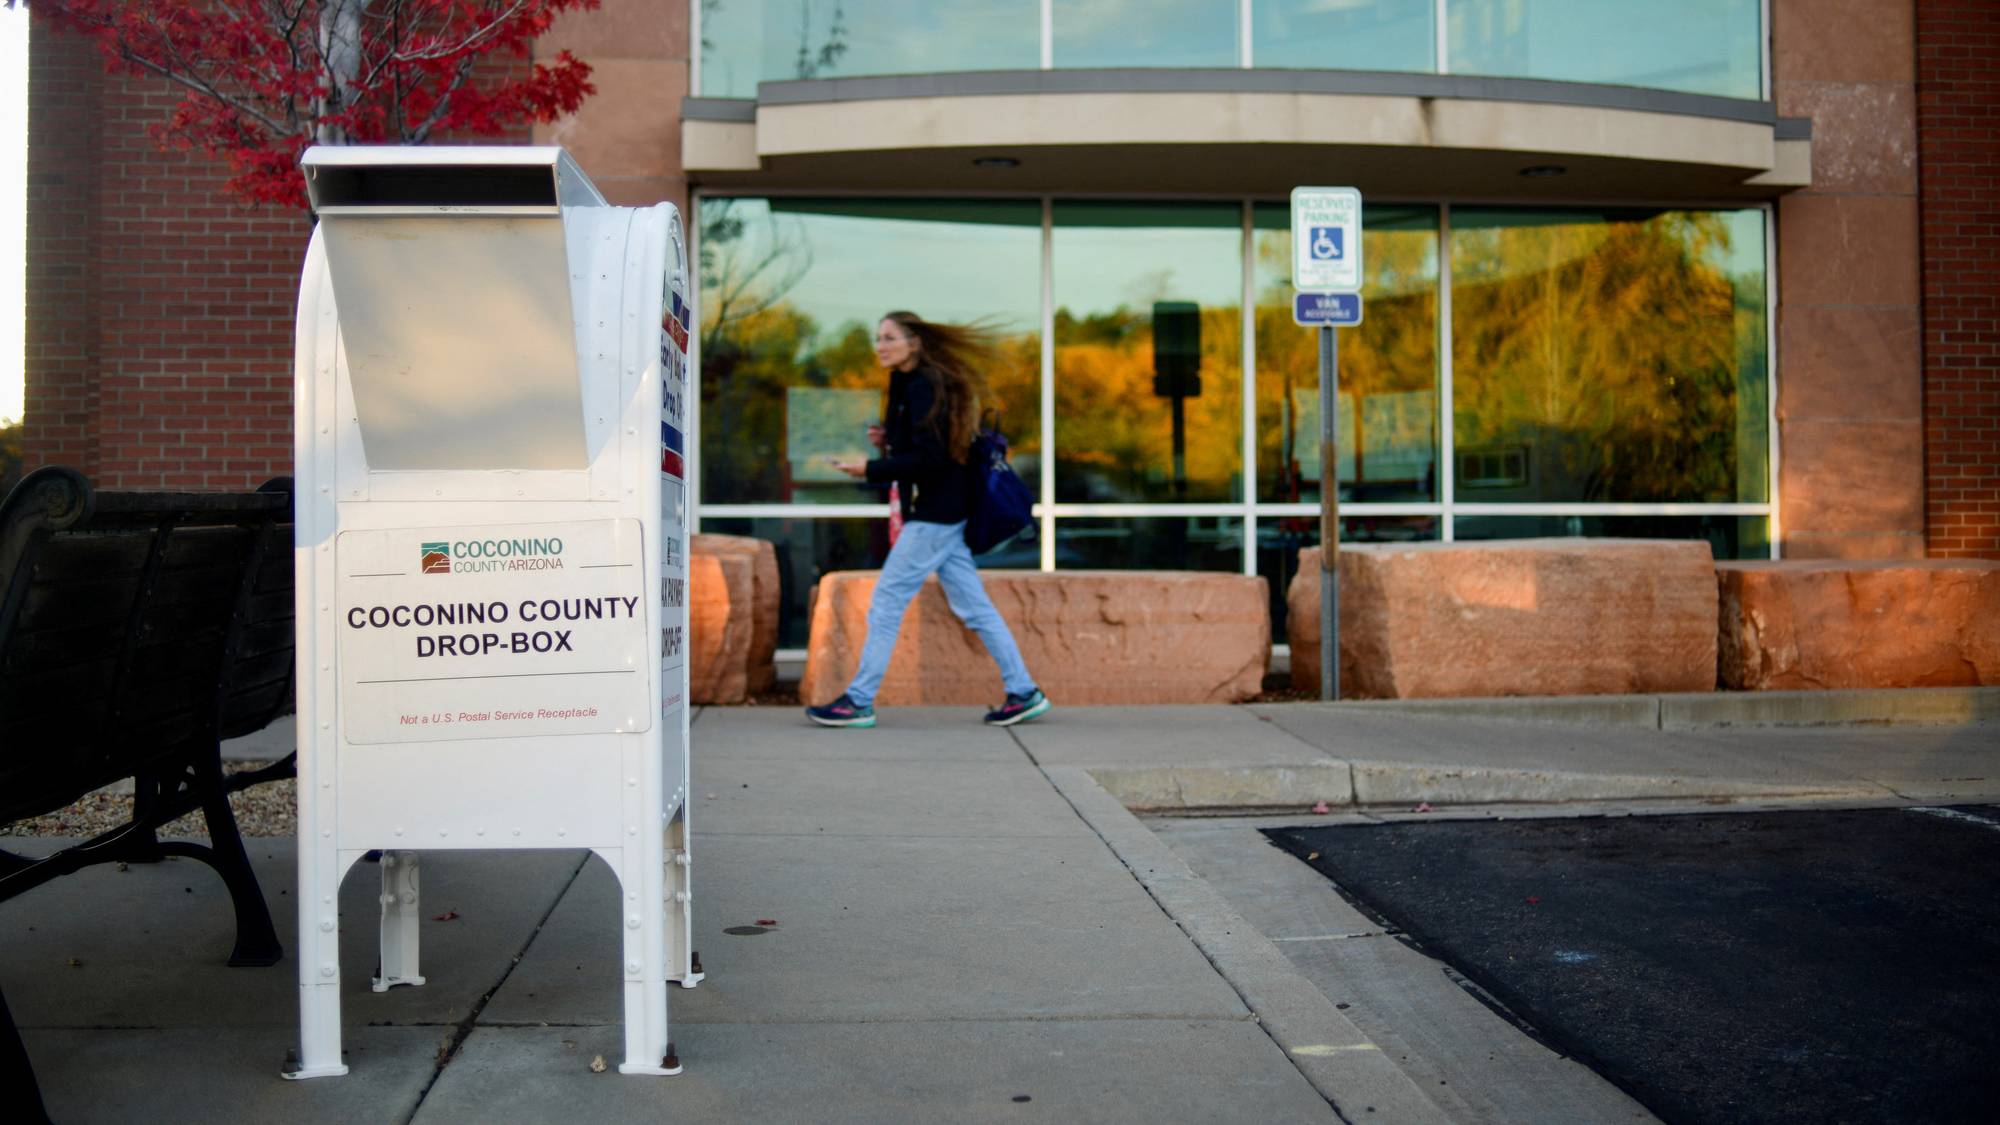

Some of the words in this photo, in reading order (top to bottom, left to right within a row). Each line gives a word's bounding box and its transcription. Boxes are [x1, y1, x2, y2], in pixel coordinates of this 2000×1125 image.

[1304, 212, 1349, 223] PARKING
[1316, 298, 1341, 309] VAN
[453, 537, 563, 559] COCONINO
[347, 602, 509, 629] COCONINO
[519, 596, 640, 623] COUNTY
[416, 630, 573, 658] DROP-BOX
[400, 714, 418, 726] Not
[421, 716, 429, 724] a
[432, 712, 455, 724] U.S.
[458, 711, 491, 723] Postal
[494, 709, 534, 721] Service
[537, 706, 598, 720] Receptacle
